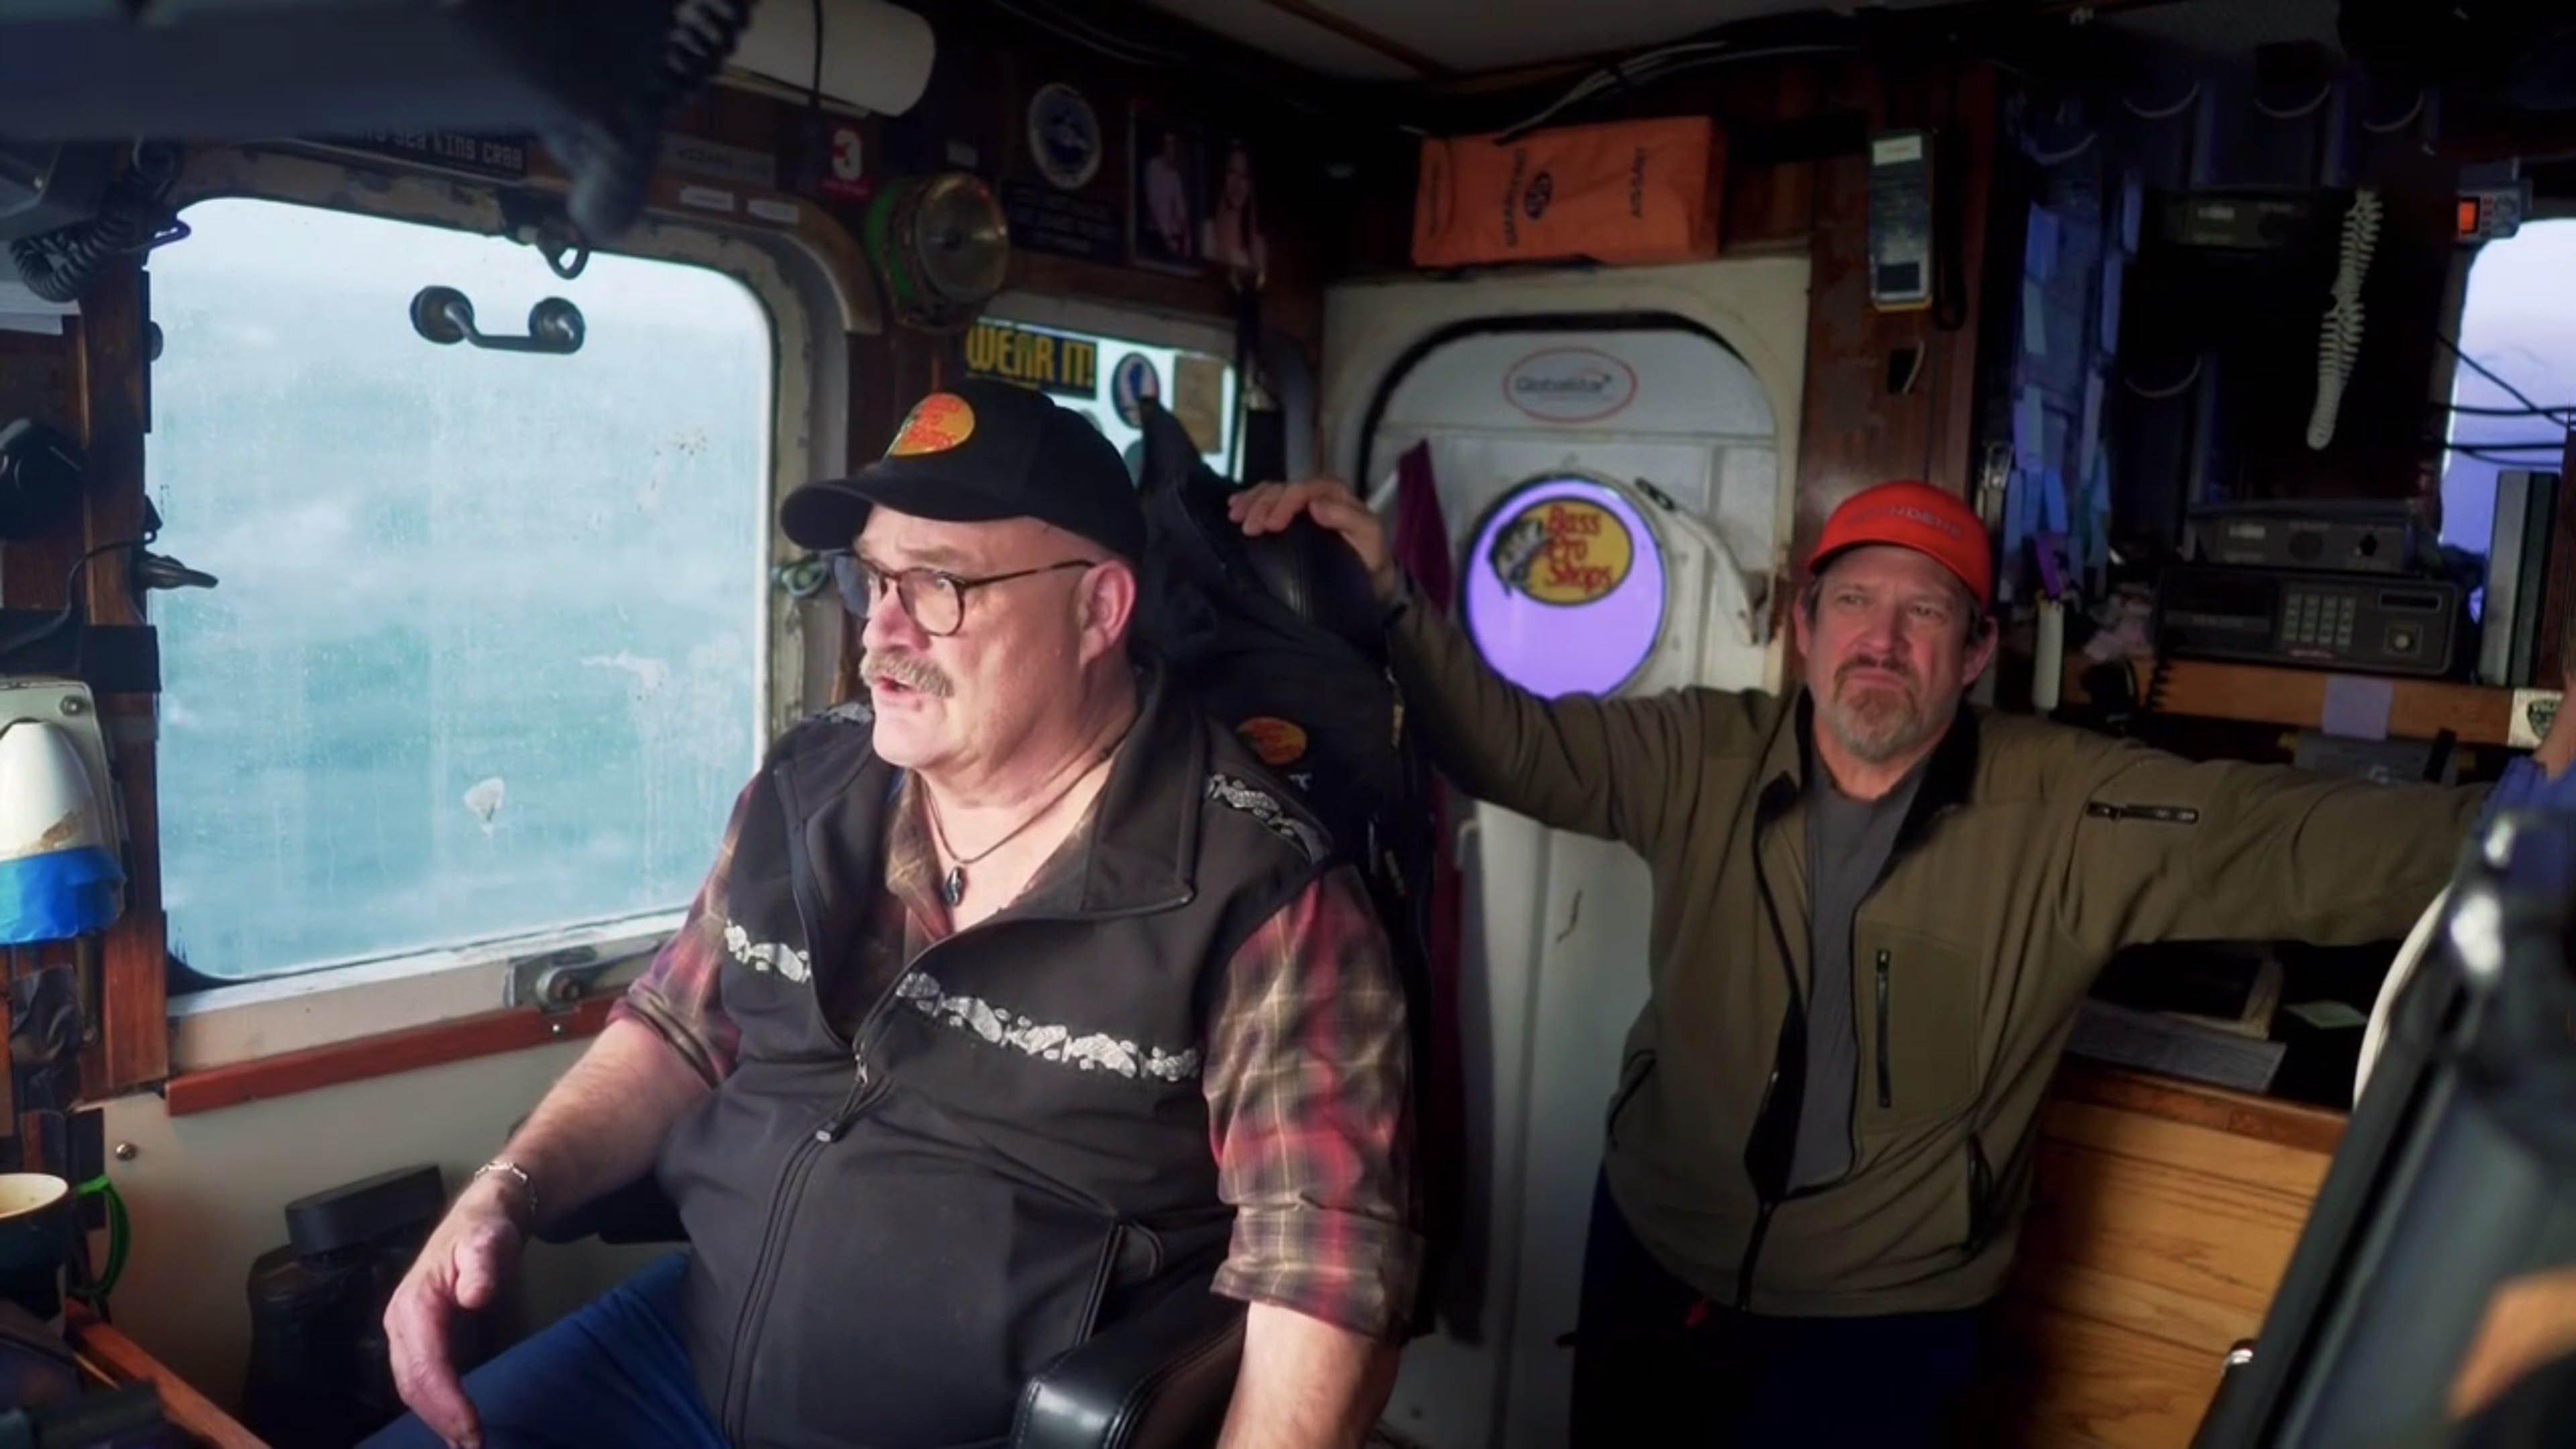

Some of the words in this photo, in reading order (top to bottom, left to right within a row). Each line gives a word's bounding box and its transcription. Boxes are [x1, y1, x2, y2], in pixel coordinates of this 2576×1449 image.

[832, 128, 863, 180] 3
[964, 325, 1056, 384] WEAR
[1547, 504, 1602, 535] Bass
[1544, 536, 1588, 570] Pro
[1544, 564, 1613, 596] Shops
